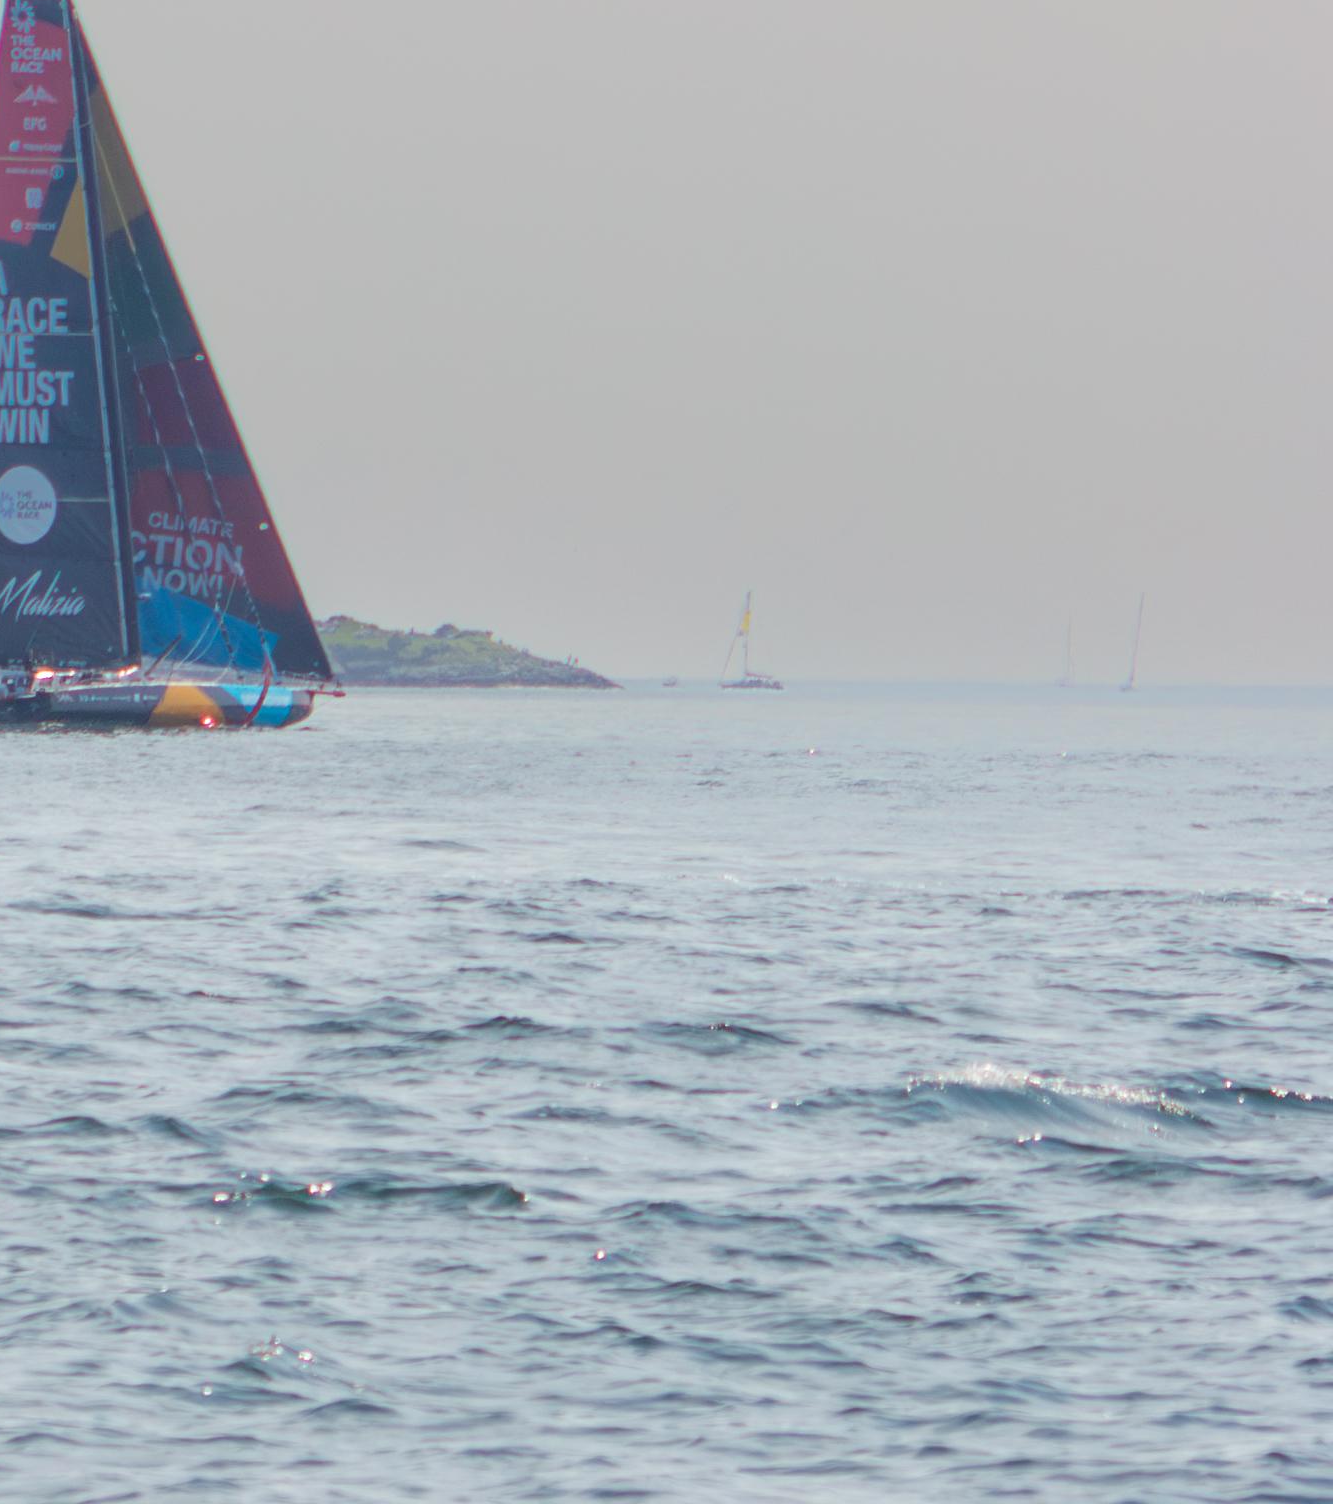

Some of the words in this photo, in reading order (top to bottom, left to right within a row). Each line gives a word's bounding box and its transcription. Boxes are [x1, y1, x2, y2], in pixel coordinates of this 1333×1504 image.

[11, 34, 36, 46] THE
[11, 47, 62, 61] OCEAN
[11, 61, 44, 74] RACE
[17, 490, 32, 500] THE
[17, 500, 53, 510] OCEAN
[17, 511, 40, 520] RACE
[148, 511, 234, 538] CLIMATE
[132, 530, 244, 575] CTION
[143, 565, 223, 598] NOW!
